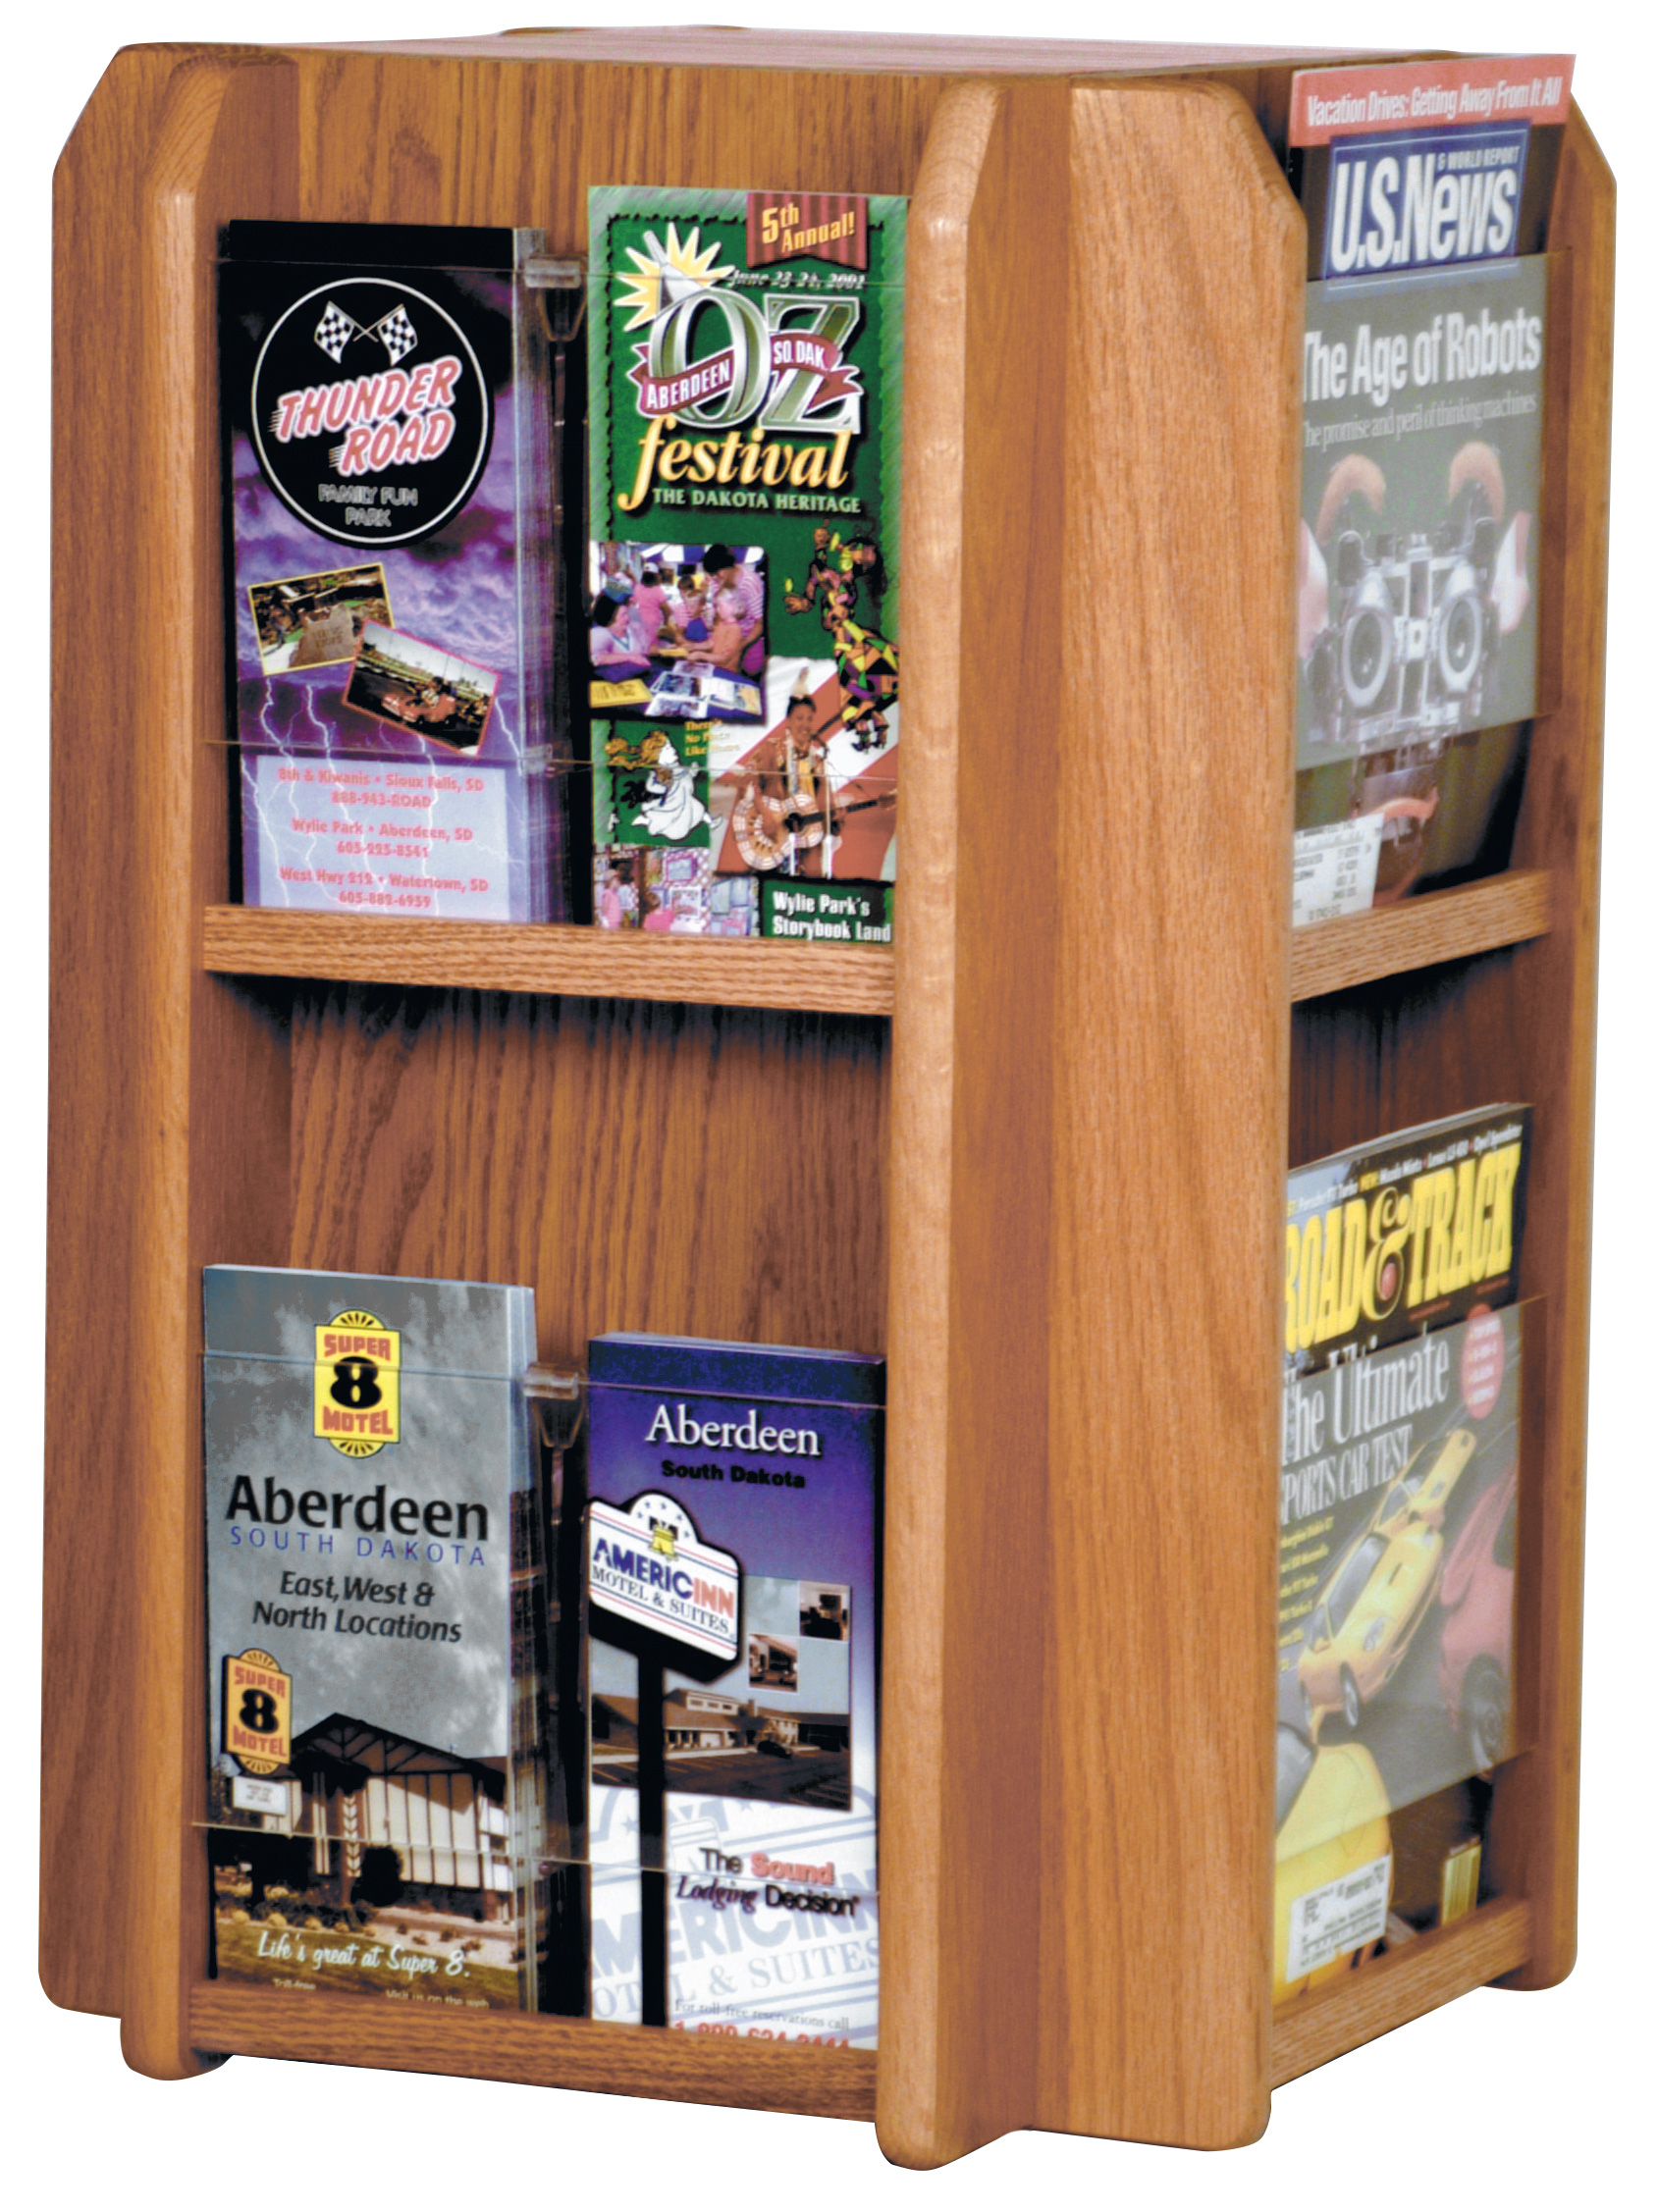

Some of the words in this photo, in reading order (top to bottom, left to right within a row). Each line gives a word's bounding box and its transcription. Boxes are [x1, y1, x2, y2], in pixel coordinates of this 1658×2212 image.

[1308, 93, 1365, 126] Vacation
[1367, 90, 1410, 121] Drives:
[1411, 84, 1457, 120] Getting
[1459, 82, 1496, 117] Away
[1495, 79, 1529, 110] From
[1531, 77, 1544, 106] It
[1543, 76, 1563, 105] All
[1448, 149, 1481, 171] WORLD
[1482, 146, 1521, 167] REPORT
[762, 202, 799, 243] 5th
[781, 211, 856, 253] Annual!
[727, 270, 770, 289] June
[648, 286, 862, 434] OZ
[1303, 330, 1348, 403] The
[1352, 323, 1408, 407] Age
[1413, 314, 1443, 387] of
[1446, 306, 1543, 383] Robots
[276, 355, 461, 443] THUNDER
[646, 358, 731, 410] ABERDEEN
[1304, 420, 1323, 448] he
[1323, 412, 1370, 452] promise
[1370, 406, 1394, 438] and
[1436, 396, 1482, 430] thinking
[1483, 390, 1538, 420] machines
[340, 408, 455, 476] ROAD
[617, 413, 854, 510] festival
[318, 484, 378, 505] FAMILY
[381, 486, 418, 507] FUN
[345, 505, 393, 527] PARK
[652, 488, 685, 505] THE
[692, 490, 769, 509] DAKOTA
[776, 494, 861, 513] HERITAGE
[278, 766, 300, 782] 8th
[303, 767, 315, 782] &
[318, 768, 371, 785] Kiwanis
[386, 772, 424, 789] Sioux
[427, 775, 462, 794] Falls,
[465, 777, 485, 793] SD
[331, 790, 433, 809] 888-943-ROAD
[292, 817, 328, 835] Wylie
[331, 819, 364, 836] Park
[379, 822, 452, 843] Aberdeen,
[455, 827, 473, 842] SD
[336, 841, 429, 859] 605-225-8541
[279, 867, 313, 882] West
[315, 869, 345, 886] Hwy
[348, 870, 373, 886] 212
[389, 872, 466, 894] Watertown,
[470, 878, 489, 893] SD
[339, 890, 432, 909] 605-882-6959
[773, 890, 816, 916] Wylie
[819, 893, 871, 917] Park's
[773, 916, 851, 941] Storybook
[856, 919, 892, 943] Land
[1406, 1141, 1523, 1309] TRACK
[323, 1333, 392, 1362] SUPER
[330, 1355, 383, 1409] 8
[1328, 1321, 1450, 1446] Ultimate
[322, 1404, 394, 1436] MOTEL
[645, 1402, 822, 1456] Aberdeen
[661, 1459, 724, 1482] South
[729, 1464, 806, 1490] Dakota
[1282, 1454, 1336, 1524] PORTS
[1339, 1442, 1370, 1501] CAR
[1372, 1424, 1414, 1488] TEST
[225, 1473, 489, 1543] Aberdeen
[229, 1525, 335, 1554] SOUTH
[355, 1536, 486, 1568] DAKOTA
[343, 1575, 408, 1606] West
[412, 1581, 436, 1608] &
[592, 1537, 735, 1620] AMERICINN
[591, 1564, 649, 1603] MOTEL
[652, 1591, 666, 1609] &
[669, 1599, 730, 1635] SUITES
[251, 1600, 328, 1632] North
[334, 1607, 463, 1644] Locations
[234, 1664, 287, 1700] SUPER
[239, 1687, 280, 1735] 8
[232, 1723, 288, 1758] MOTEL
[699, 1846, 743, 1875] The
[750, 1851, 836, 1886] Sound
[675, 1874, 760, 1915] Lodging
[257, 1929, 306, 1963] Life's
[312, 1941, 360, 1972] great
[360, 1947, 382, 1969] at
[387, 1943, 439, 1981] Super
[675, 1999, 696, 2013] For
[752, 2009, 826, 2028] reservations
[828, 2017, 850, 2031] call
